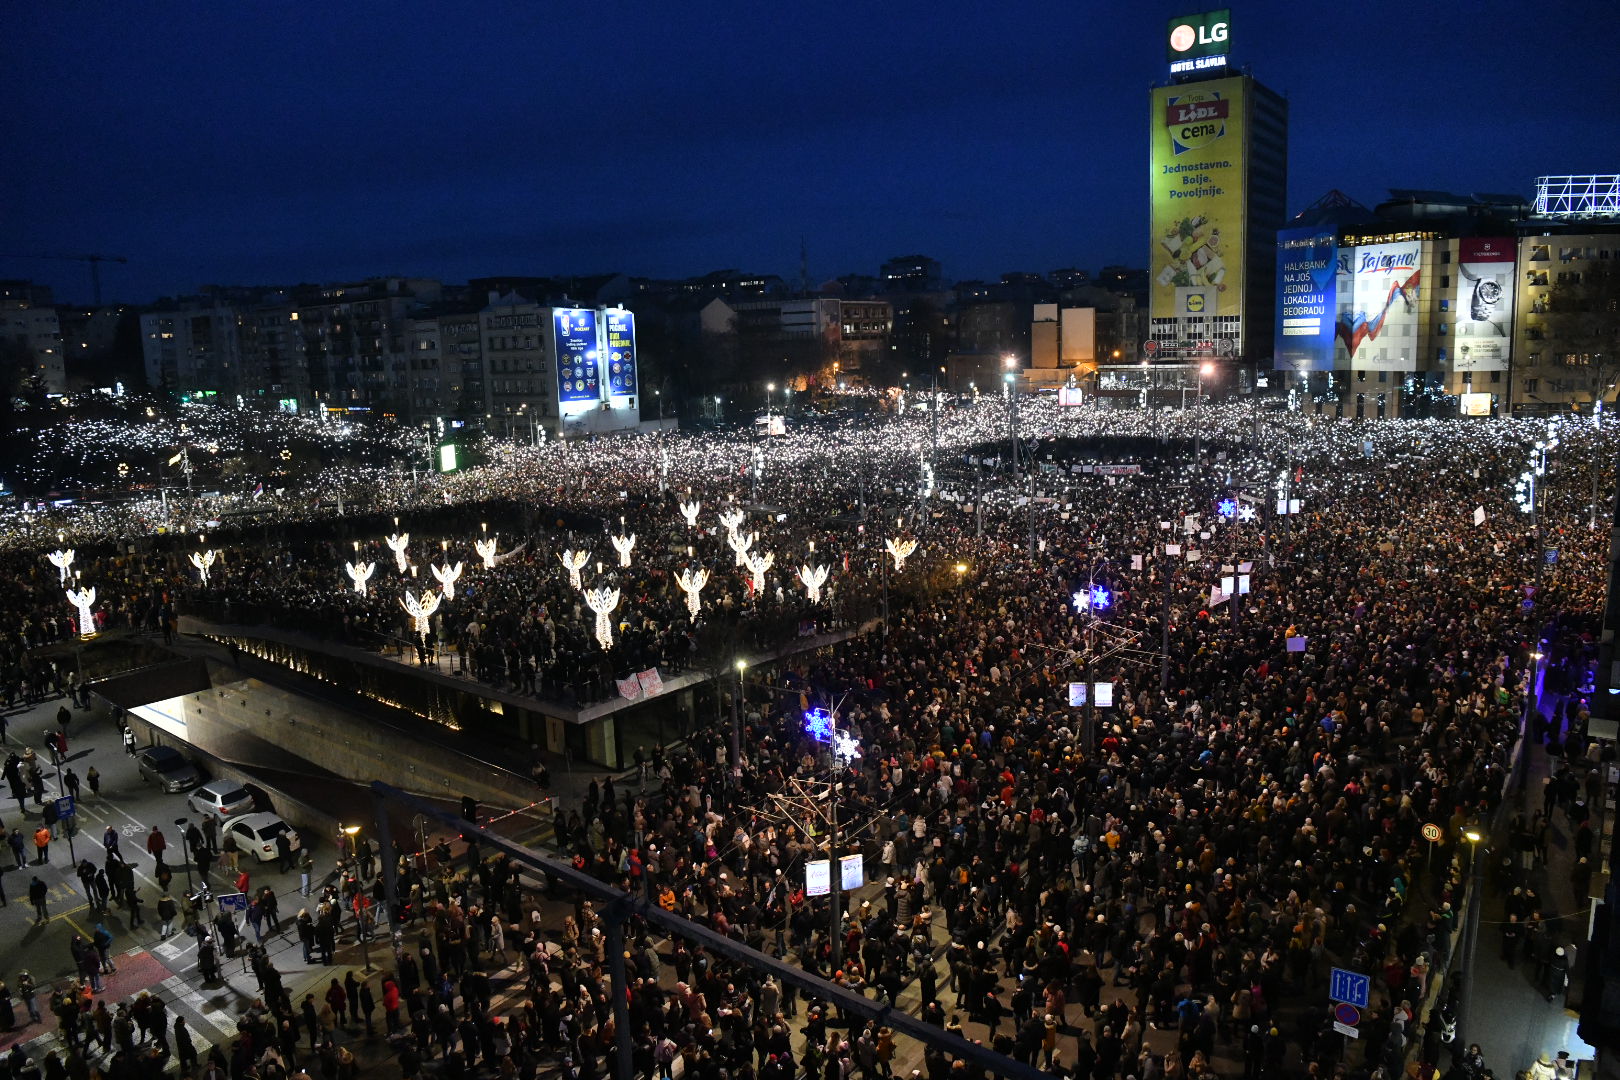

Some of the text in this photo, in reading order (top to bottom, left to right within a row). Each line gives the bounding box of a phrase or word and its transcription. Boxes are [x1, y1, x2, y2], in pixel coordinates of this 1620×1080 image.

[1199, 22, 1227, 44] LG
[1170, 56, 1226, 73] HOTEL SLAVIJA
[1181, 124, 1216, 140] cena
[1162, 160, 1232, 174] Jednostavno.
[1182, 174, 1212, 185] Bolje.
[1169, 186, 1225, 199] Povoljnije.
[1284, 260, 1327, 272] HALKBANK
[1283, 271, 1311, 283] NA JOŠ
[1283, 283, 1313, 294] JEDNOJ
[1283, 294, 1324, 305] LOKACIJI U
[1283, 306, 1325, 316] BEOGRADU
[1425, 827, 1437, 838] 30
